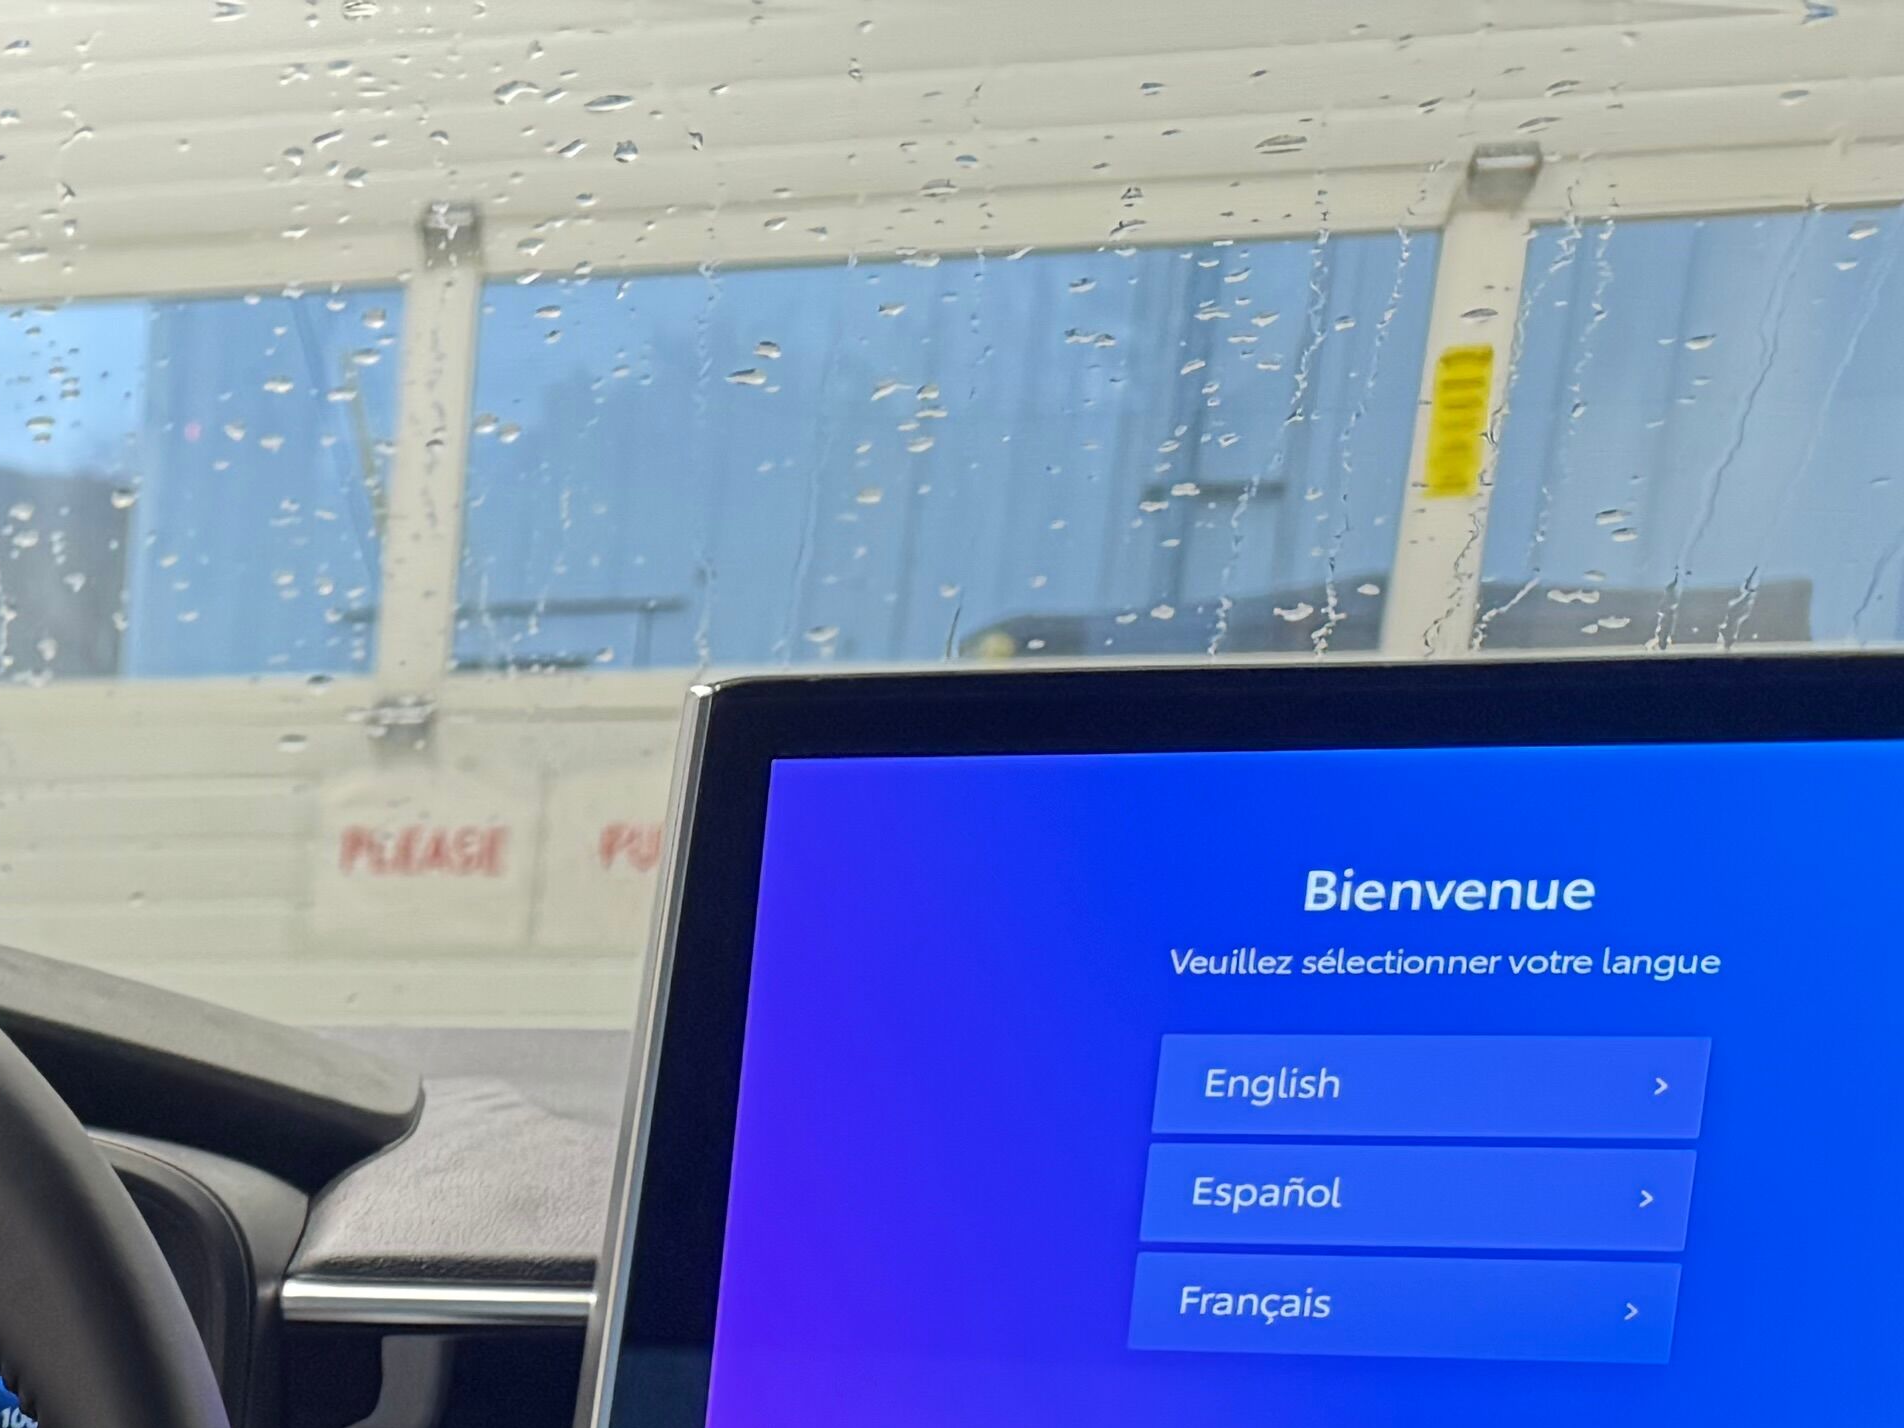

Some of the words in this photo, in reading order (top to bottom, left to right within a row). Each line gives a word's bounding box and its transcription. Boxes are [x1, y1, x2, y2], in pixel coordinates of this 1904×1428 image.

[338, 823, 509, 876] PLEASE
[1303, 868, 1596, 912] Bienvenue
[1169, 947, 1293, 976] Veuillez
[1301, 947, 1502, 976] sélectionner
[1508, 951, 1594, 975] votre
[1602, 947, 1722, 982] langue
[1203, 1068, 1341, 1106] English
[1191, 1176, 1343, 1213] Español
[1178, 1285, 1331, 1325] Français
